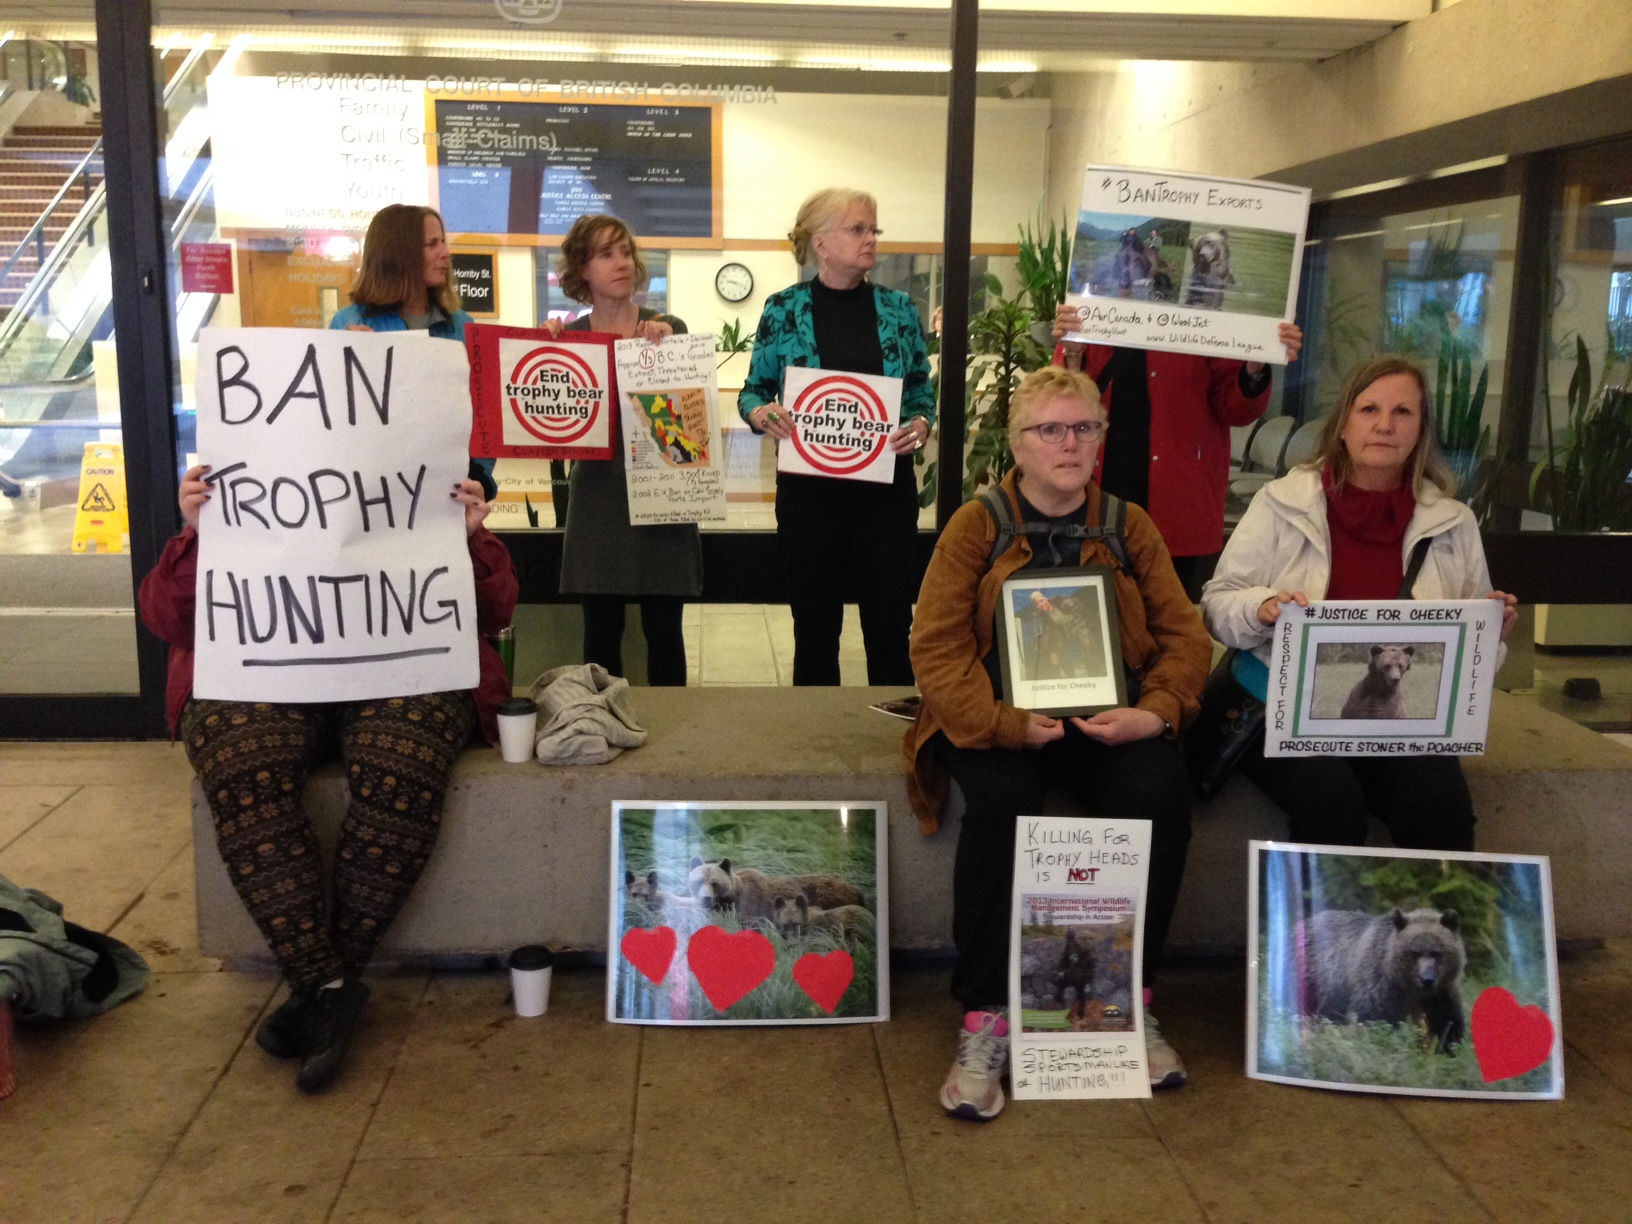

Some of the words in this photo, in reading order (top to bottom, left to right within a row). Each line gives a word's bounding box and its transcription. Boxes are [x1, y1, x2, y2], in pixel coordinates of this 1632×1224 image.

[276, 72, 413, 93] PROVINCIAL
[425, 76, 507, 96] COURT
[518, 77, 549, 97] OF
[560, 79, 648, 101] BRITISH
[661, 82, 778, 104] COLUMBIA
[339, 97, 409, 122] Family
[339, 125, 385, 144] Civil
[400, 127, 470, 151] (Small
[475, 129, 558, 158] Claims)
[340, 152, 406, 173] Traffic
[344, 182, 404, 200] Youth
[460, 283, 490, 298] Floor
[216, 342, 394, 430] BAN
[540, 370, 571, 384] End
[505, 384, 562, 401] trophy
[567, 385, 604, 400] bear
[524, 402, 589, 418] hunting
[825, 398, 859, 415] End
[852, 416, 895, 434] bear
[803, 429, 873, 452] hunting
[86, 468, 115, 476] CAUTION
[525, 477, 534, 485] of
[204, 461, 427, 532] TROPHY
[205, 566, 461, 645] HUNTING
[1376, 606, 1401, 620] FOR
[1410, 607, 1463, 620] CHEEKY
[1279, 622, 1293, 696] RESPECT
[1467, 620, 1486, 716] WILDLIFE
[1031, 683, 1056, 691] Justice
[1057, 682, 1068, 690] for
[1069, 682, 1097, 690] Cheeky
[1274, 700, 1286, 731] FOR
[1279, 740, 1354, 753] PROSECUTE
[1357, 741, 1405, 753] STONER
[1408, 742, 1425, 752] the
[1427, 741, 1484, 753] POACHER
[1028, 821, 1093, 846] KILLING
[1104, 827, 1131, 846] FOR
[1024, 848, 1082, 869] TROPHY
[1089, 849, 1140, 866] HEADS
[1037, 871, 1051, 883] IS
[1066, 867, 1101, 882] NOT
[1031, 904, 1080, 914] Management
[1082, 904, 1128, 914] Symposium
[1050, 897, 1100, 905] International
[1102, 897, 1132, 905] Wildlife
[1043, 914, 1083, 922] Stewardship
[1022, 1045, 1128, 1063] STEWARDSHIP
